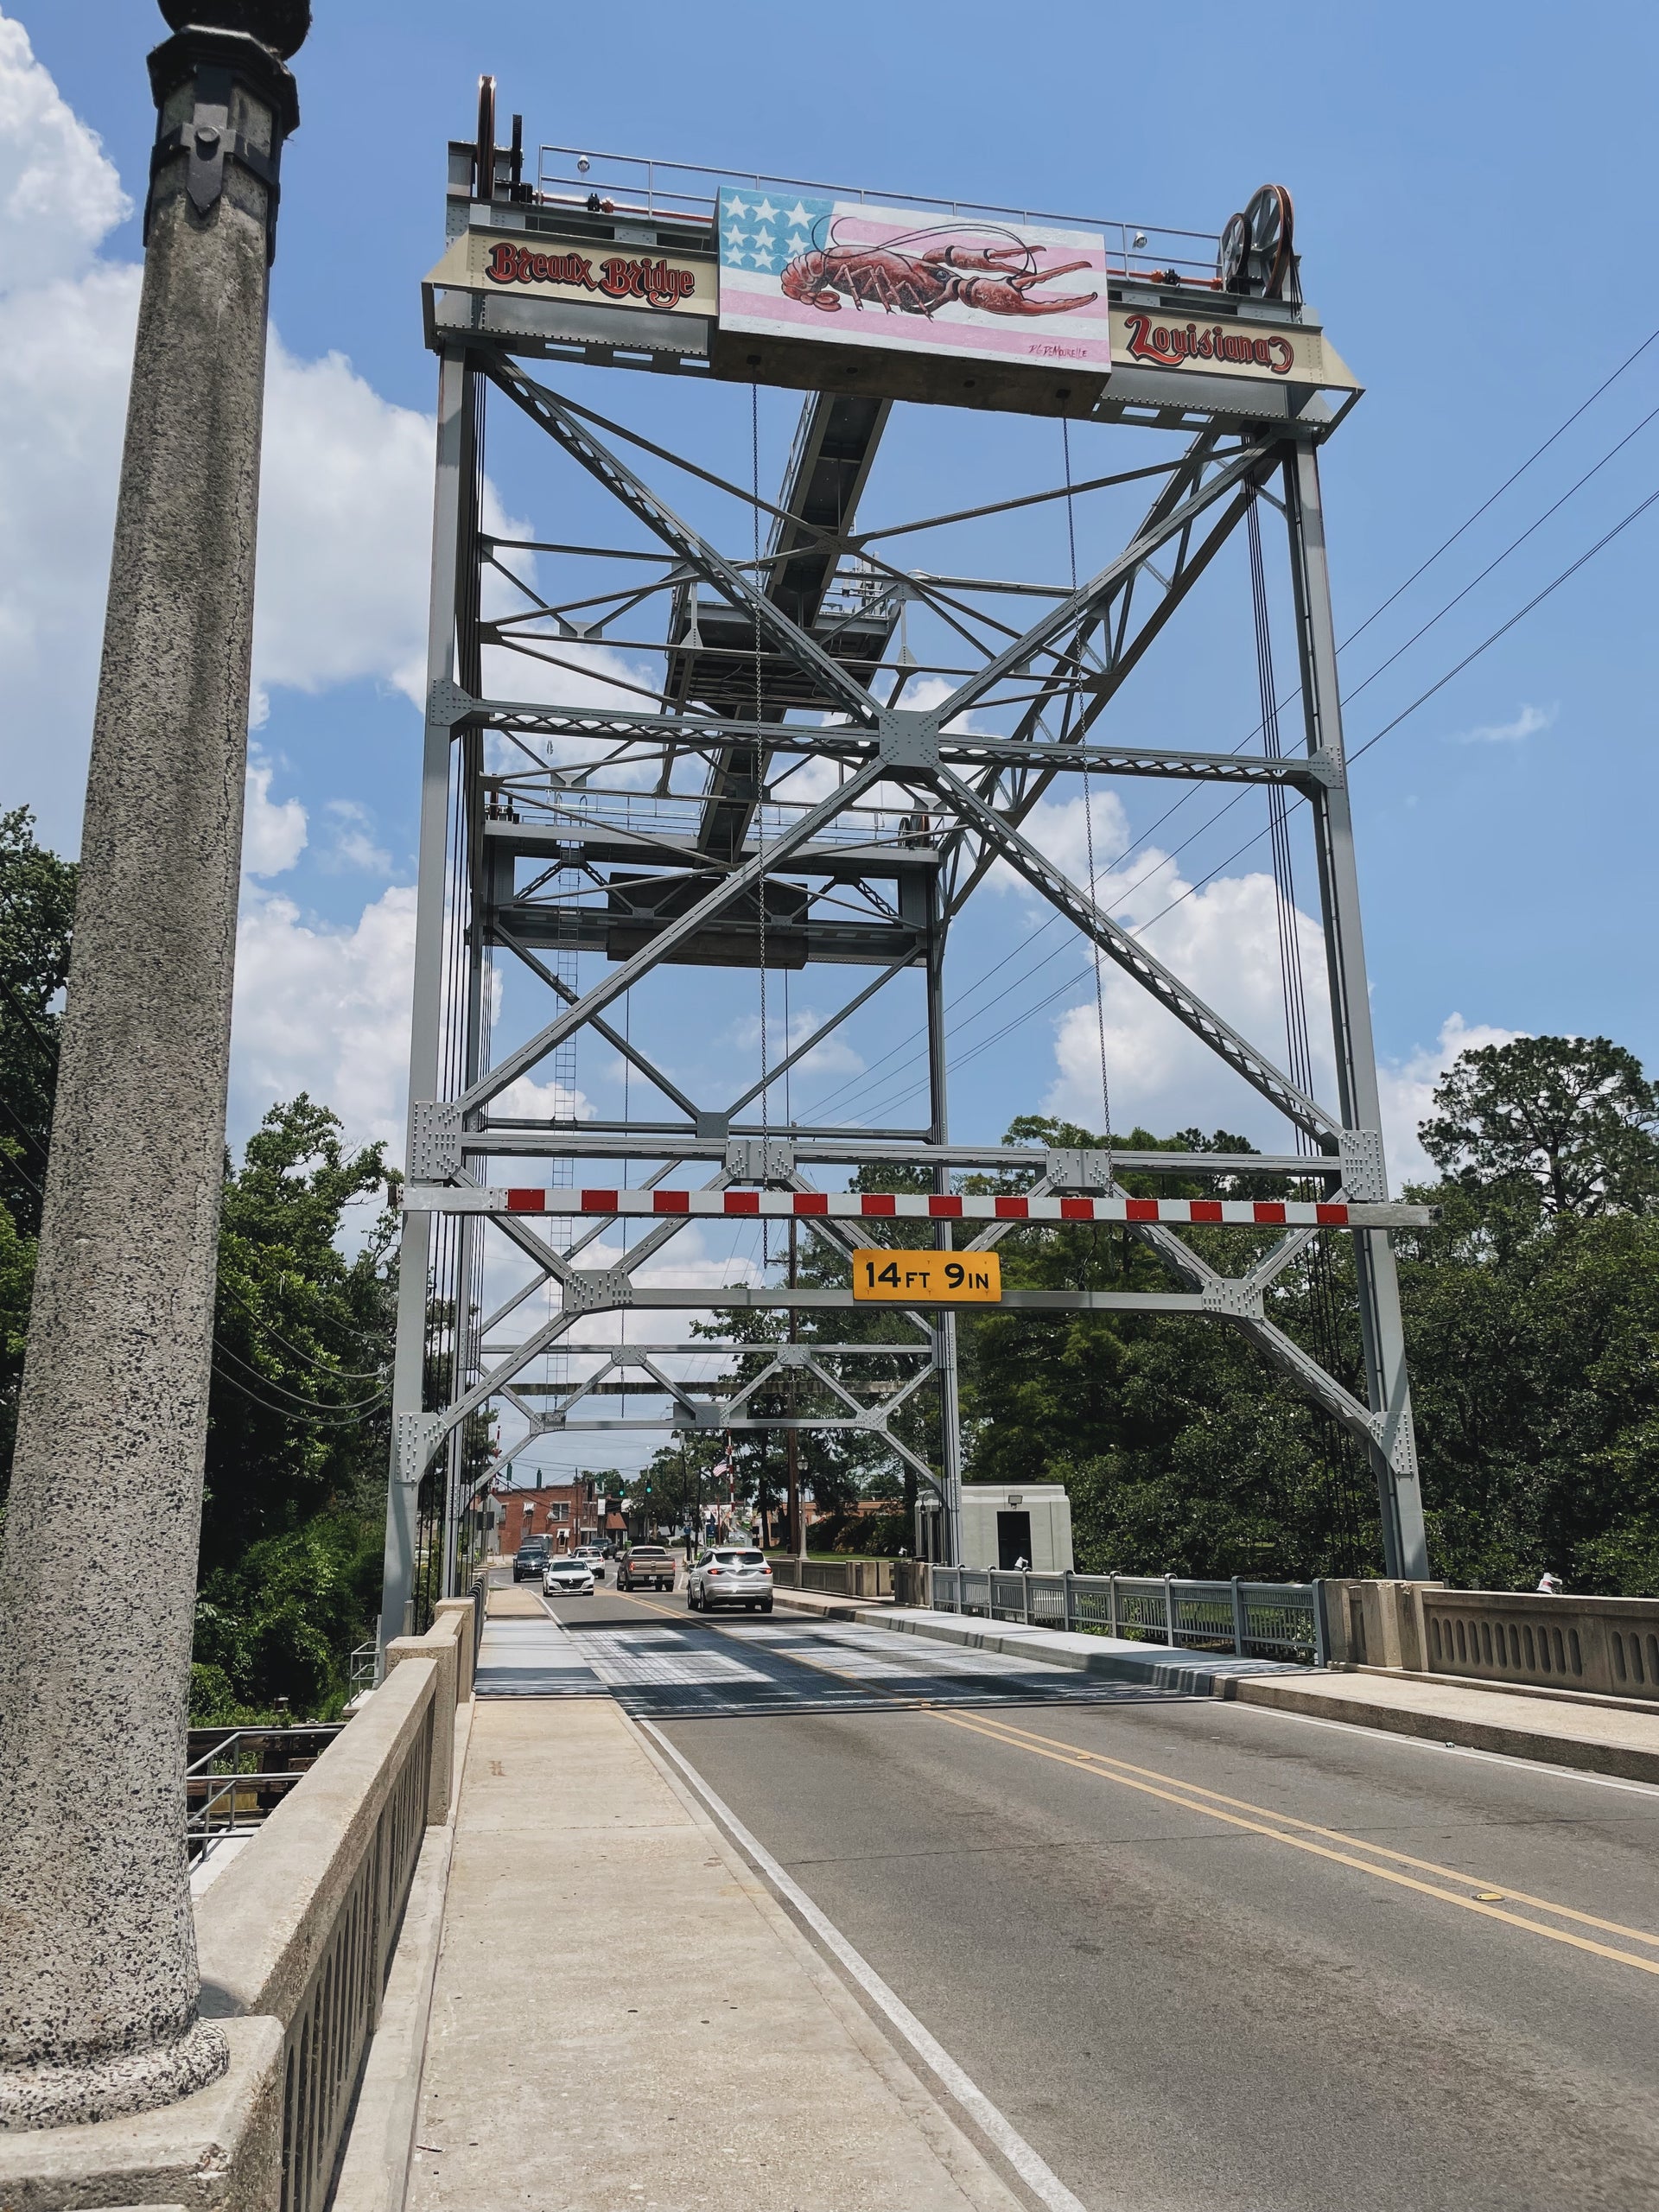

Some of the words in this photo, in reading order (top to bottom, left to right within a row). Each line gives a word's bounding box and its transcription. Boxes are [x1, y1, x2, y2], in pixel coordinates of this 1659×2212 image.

[486, 242, 599, 290] Breaux
[600, 257, 696, 308] Bridge
[1125, 315, 1294, 374] Louisiana
